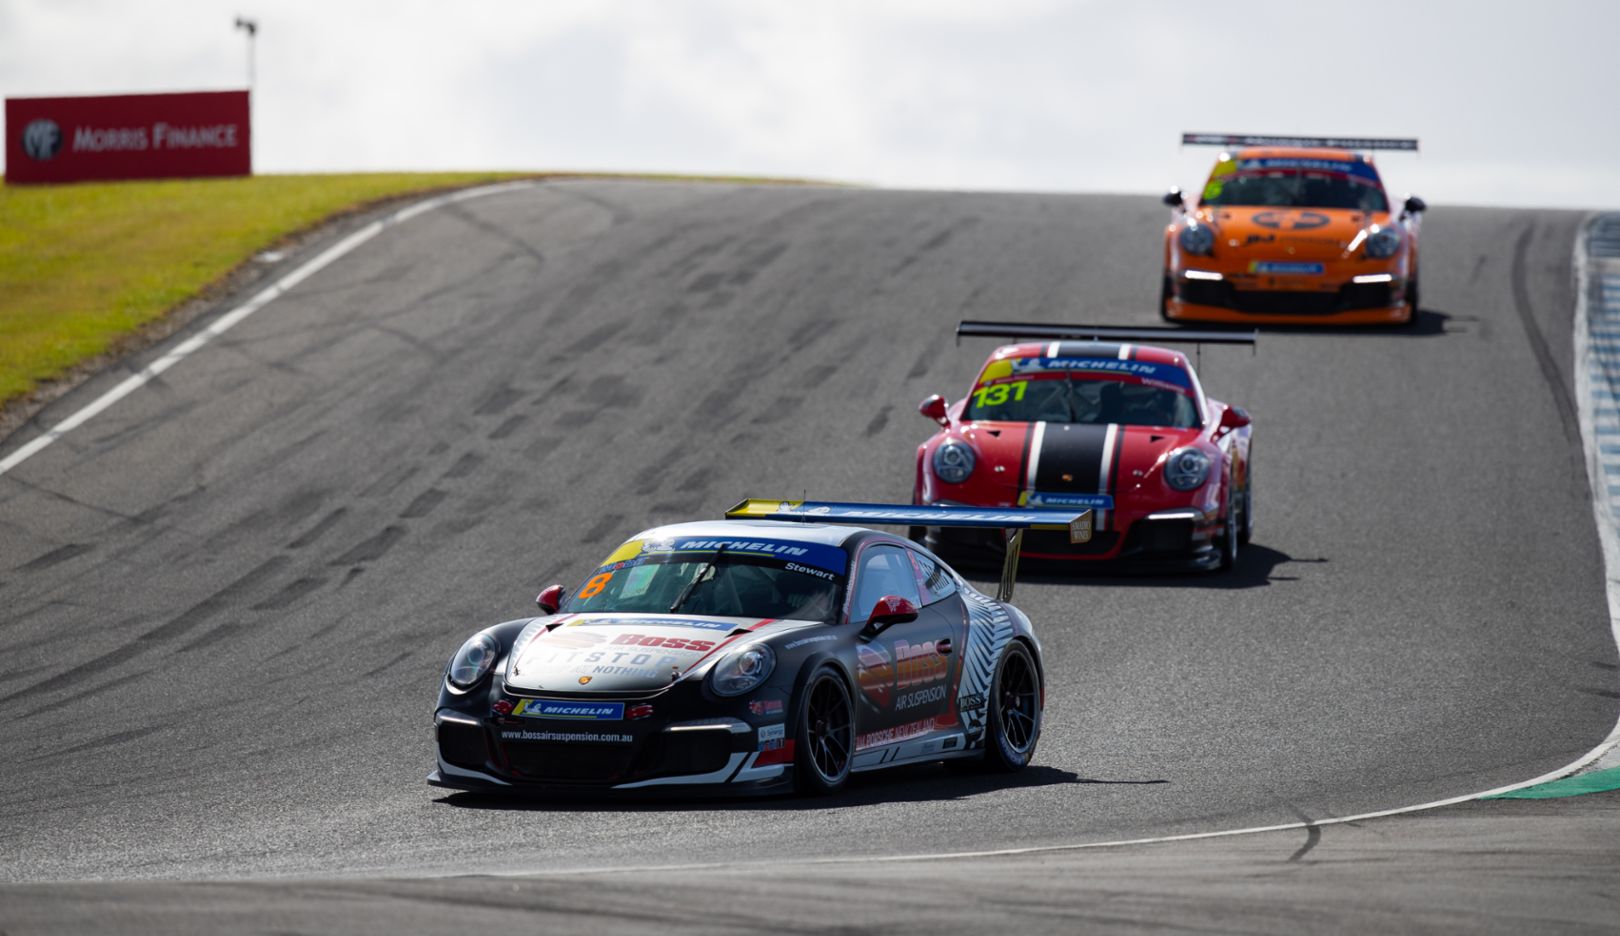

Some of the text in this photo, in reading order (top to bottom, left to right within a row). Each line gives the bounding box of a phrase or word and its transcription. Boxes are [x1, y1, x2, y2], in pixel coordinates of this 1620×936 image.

[73, 122, 238, 151] MORRIS FINANCE
[1048, 358, 1156, 375] MICHELIN
[972, 380, 1028, 409] 131
[1046, 496, 1105, 505] MICHELIN
[680, 540, 809, 557] MICHELIN
[784, 561, 836, 582] Stewart
[578, 571, 613, 599] 8
[592, 665, 658, 678] NOTHING
[895, 685, 947, 711] AIR SUSPENSION
[543, 706, 614, 715] MICHELIN
[501, 729, 633, 743] www.bossairsuspension.com.au
[867, 727, 895, 746] PORSCHE
[896, 724, 909, 738] NEW
